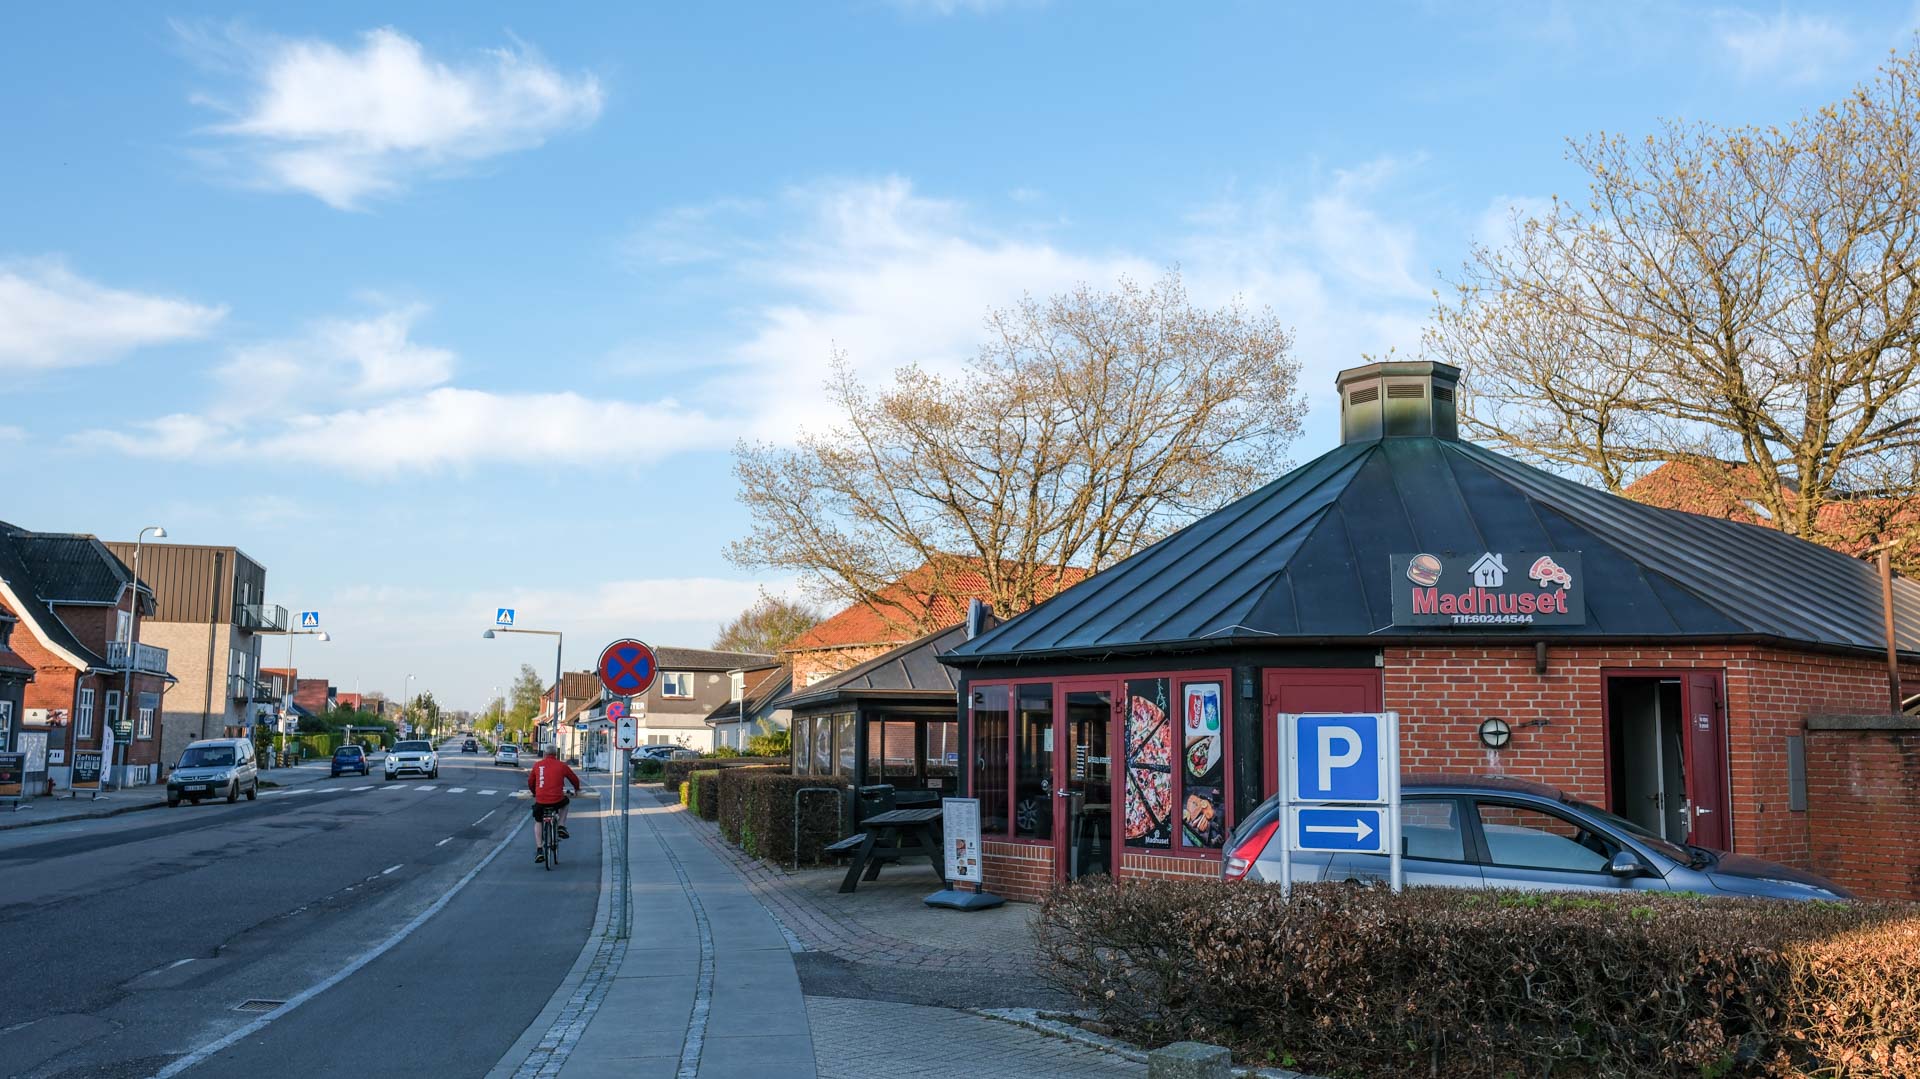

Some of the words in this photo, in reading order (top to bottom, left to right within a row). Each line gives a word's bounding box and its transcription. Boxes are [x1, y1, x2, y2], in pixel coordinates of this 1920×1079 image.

[1412, 587, 1568, 614] Madhuset
[1317, 726, 1362, 791] P
[1145, 836, 1169, 844] Madhuset
